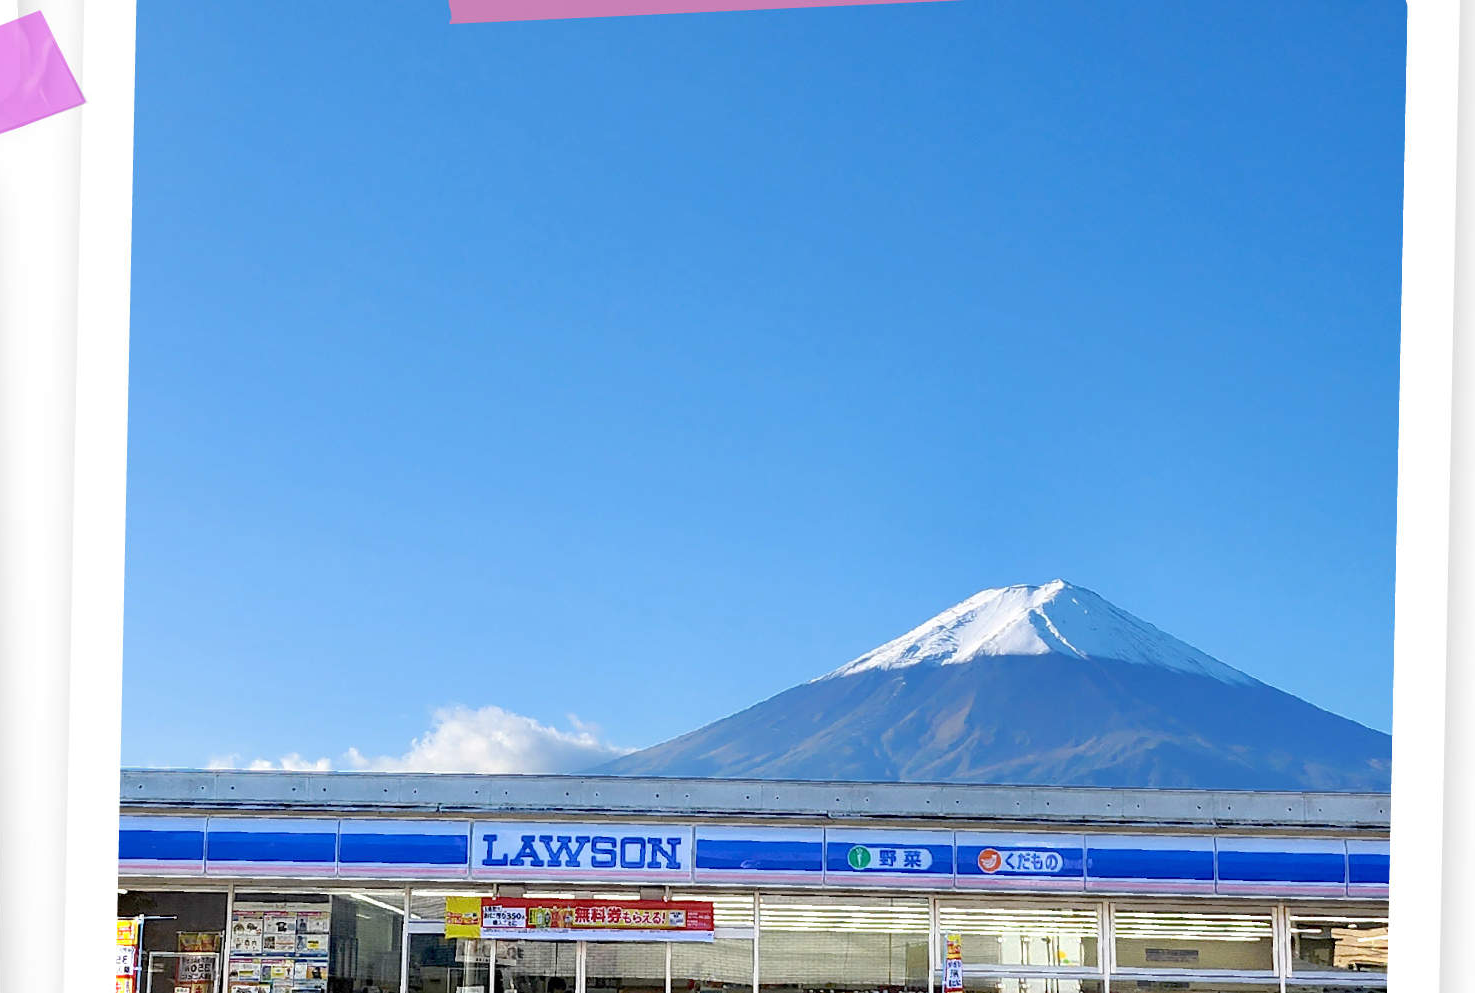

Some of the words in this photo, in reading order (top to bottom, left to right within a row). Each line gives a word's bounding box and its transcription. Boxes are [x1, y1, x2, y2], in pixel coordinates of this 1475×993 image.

[482, 834, 682, 869] LAWSON
[879, 850, 922, 867] 野菜
[1005, 852, 1058, 870] くだもの
[574, 906, 666, 925] 無料券もらえる!
